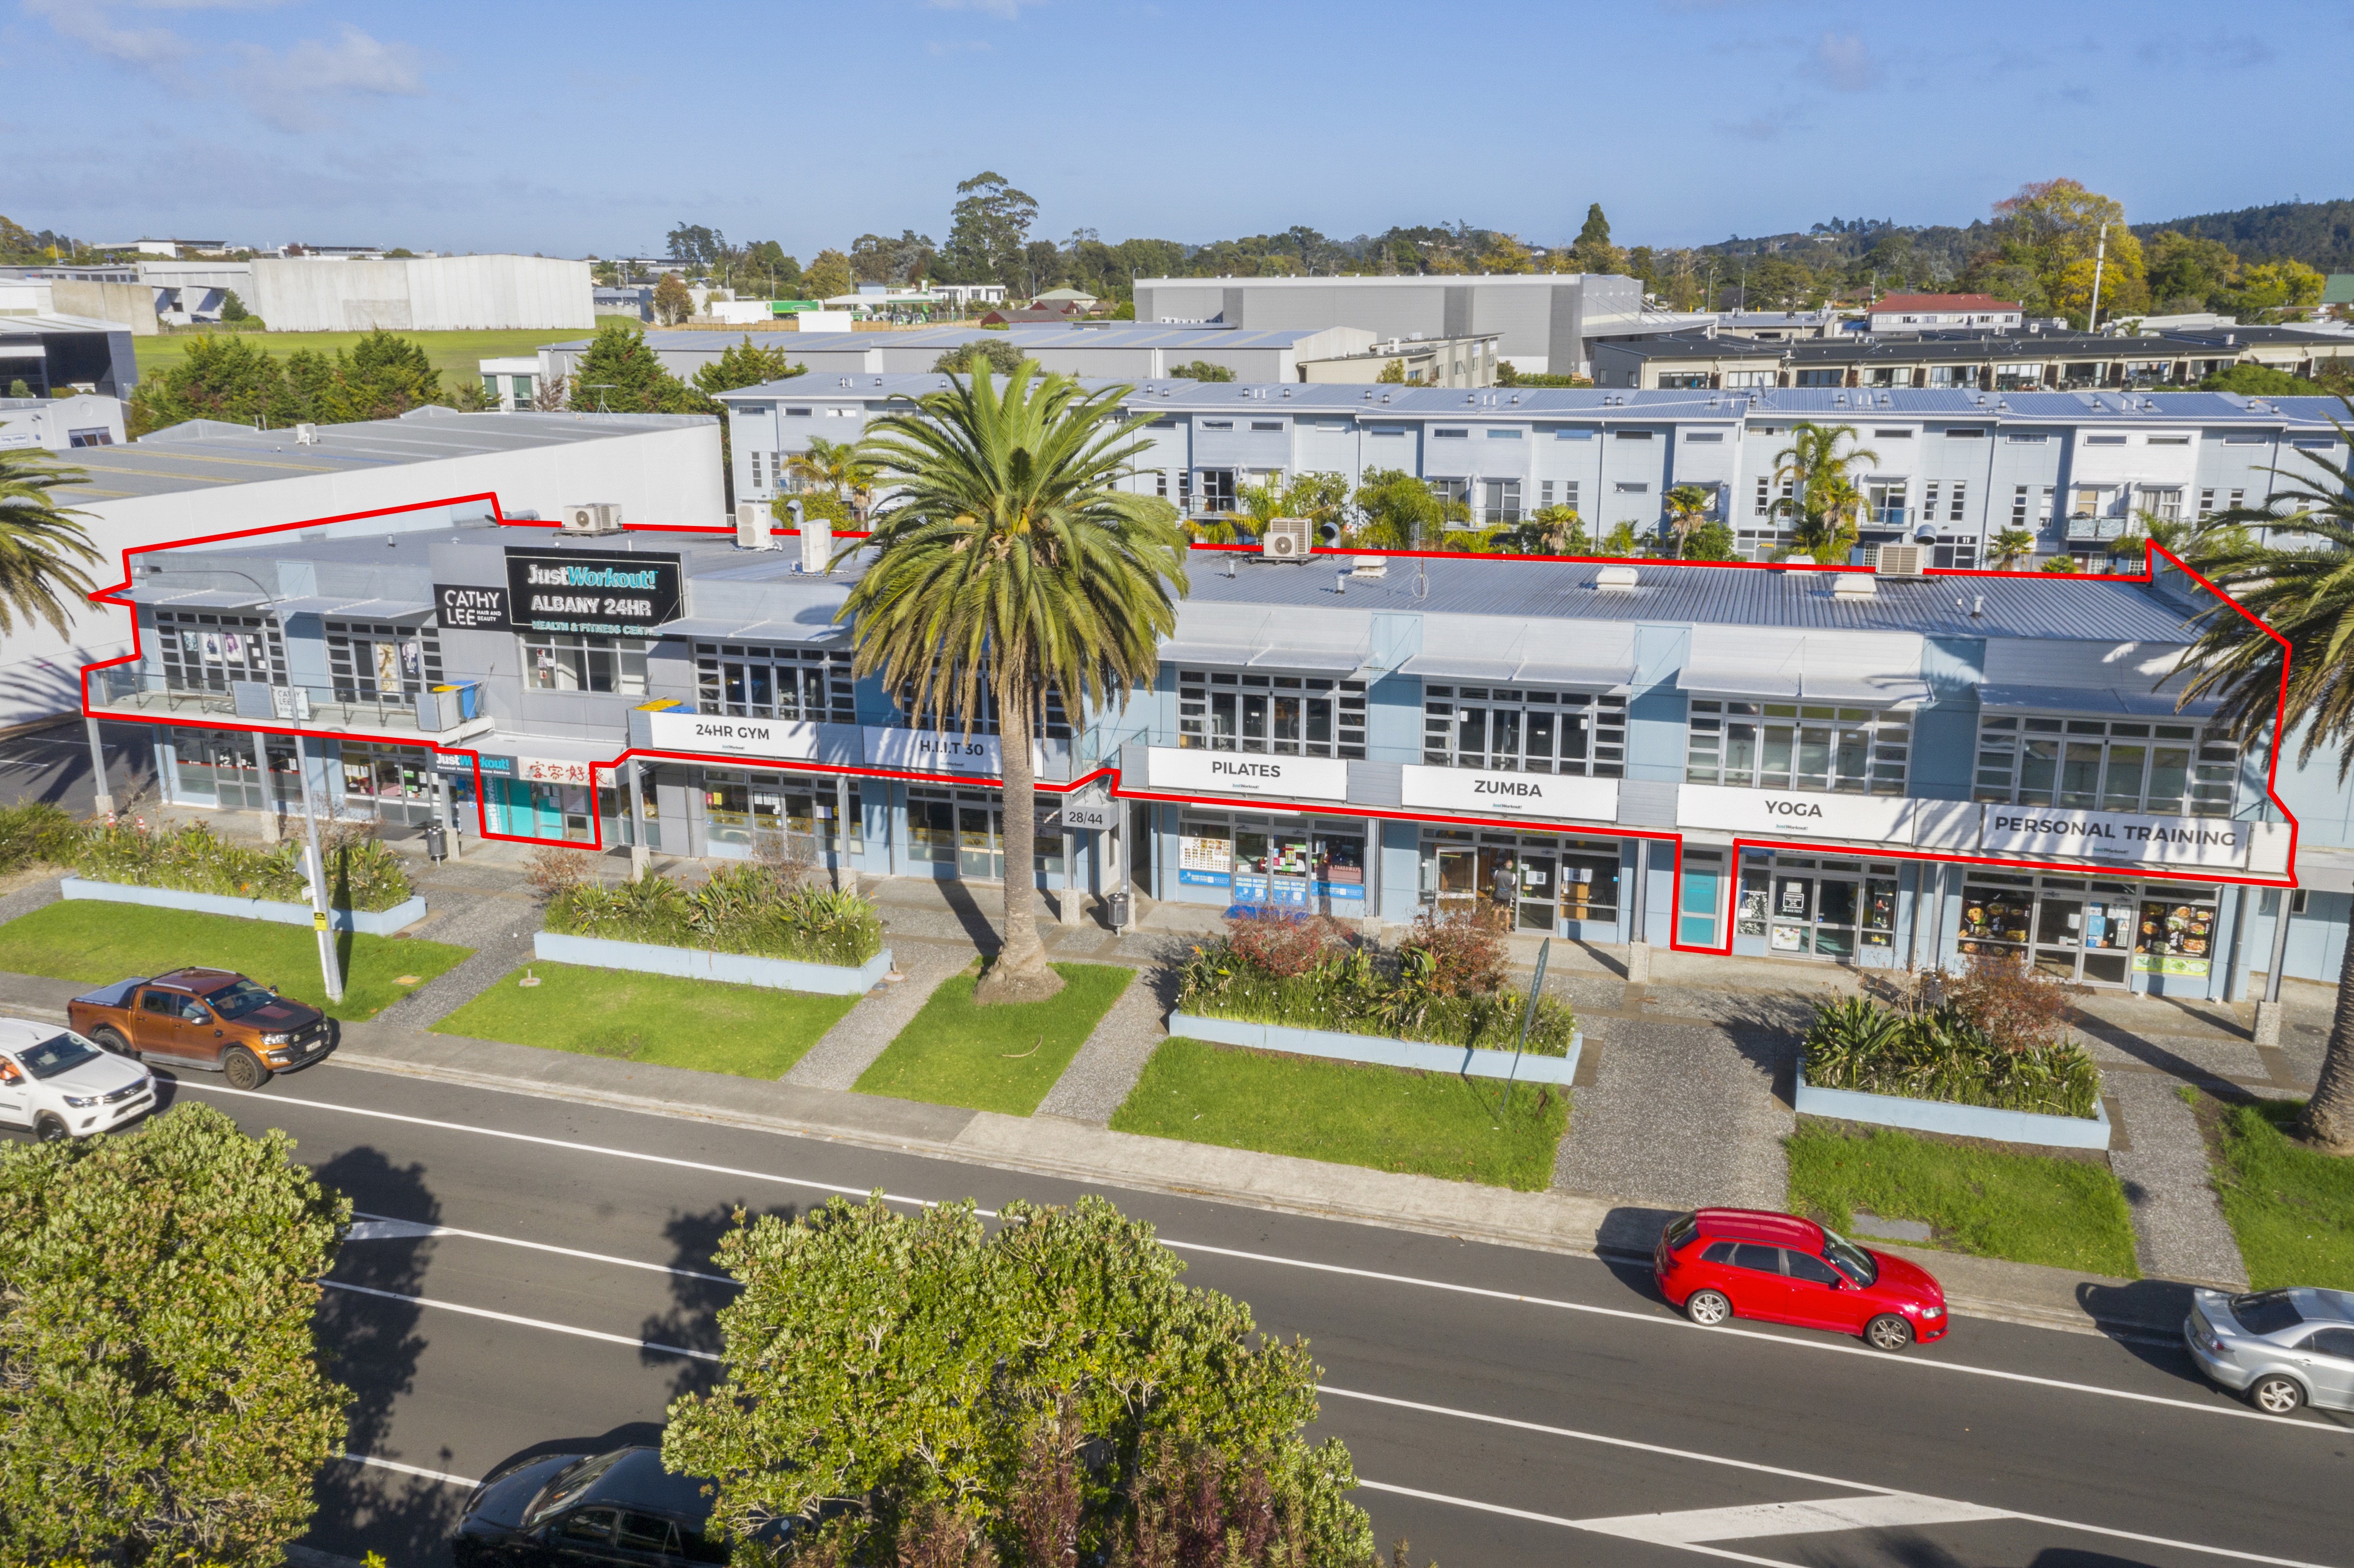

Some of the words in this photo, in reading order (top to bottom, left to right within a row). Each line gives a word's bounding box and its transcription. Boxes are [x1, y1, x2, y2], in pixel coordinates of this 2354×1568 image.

[528, 564, 656, 589] JustWorkout!
[444, 590, 500, 608] CATHY
[531, 595, 600, 614] ALBANY
[604, 598, 651, 616] 24HR
[447, 608, 477, 625] LEE
[532, 620, 569, 631] HEALTH
[570, 622, 578, 632] &
[580, 624, 621, 634] FITNESS
[622, 625, 663, 636] CENT
[696, 724, 733, 737] 24HR
[737, 727, 770, 740] GYM
[920, 740, 961, 754] H.I.I.T
[965, 743, 984, 756] 30
[1212, 761, 1281, 777] PILATES
[1474, 780, 1542, 797] ZUMBA
[1765, 800, 1823, 817] YOGA
[1069, 811, 1103, 824] 28/44
[1995, 816, 2116, 838] PERSONAL
[2123, 825, 2236, 846] TRAINING
